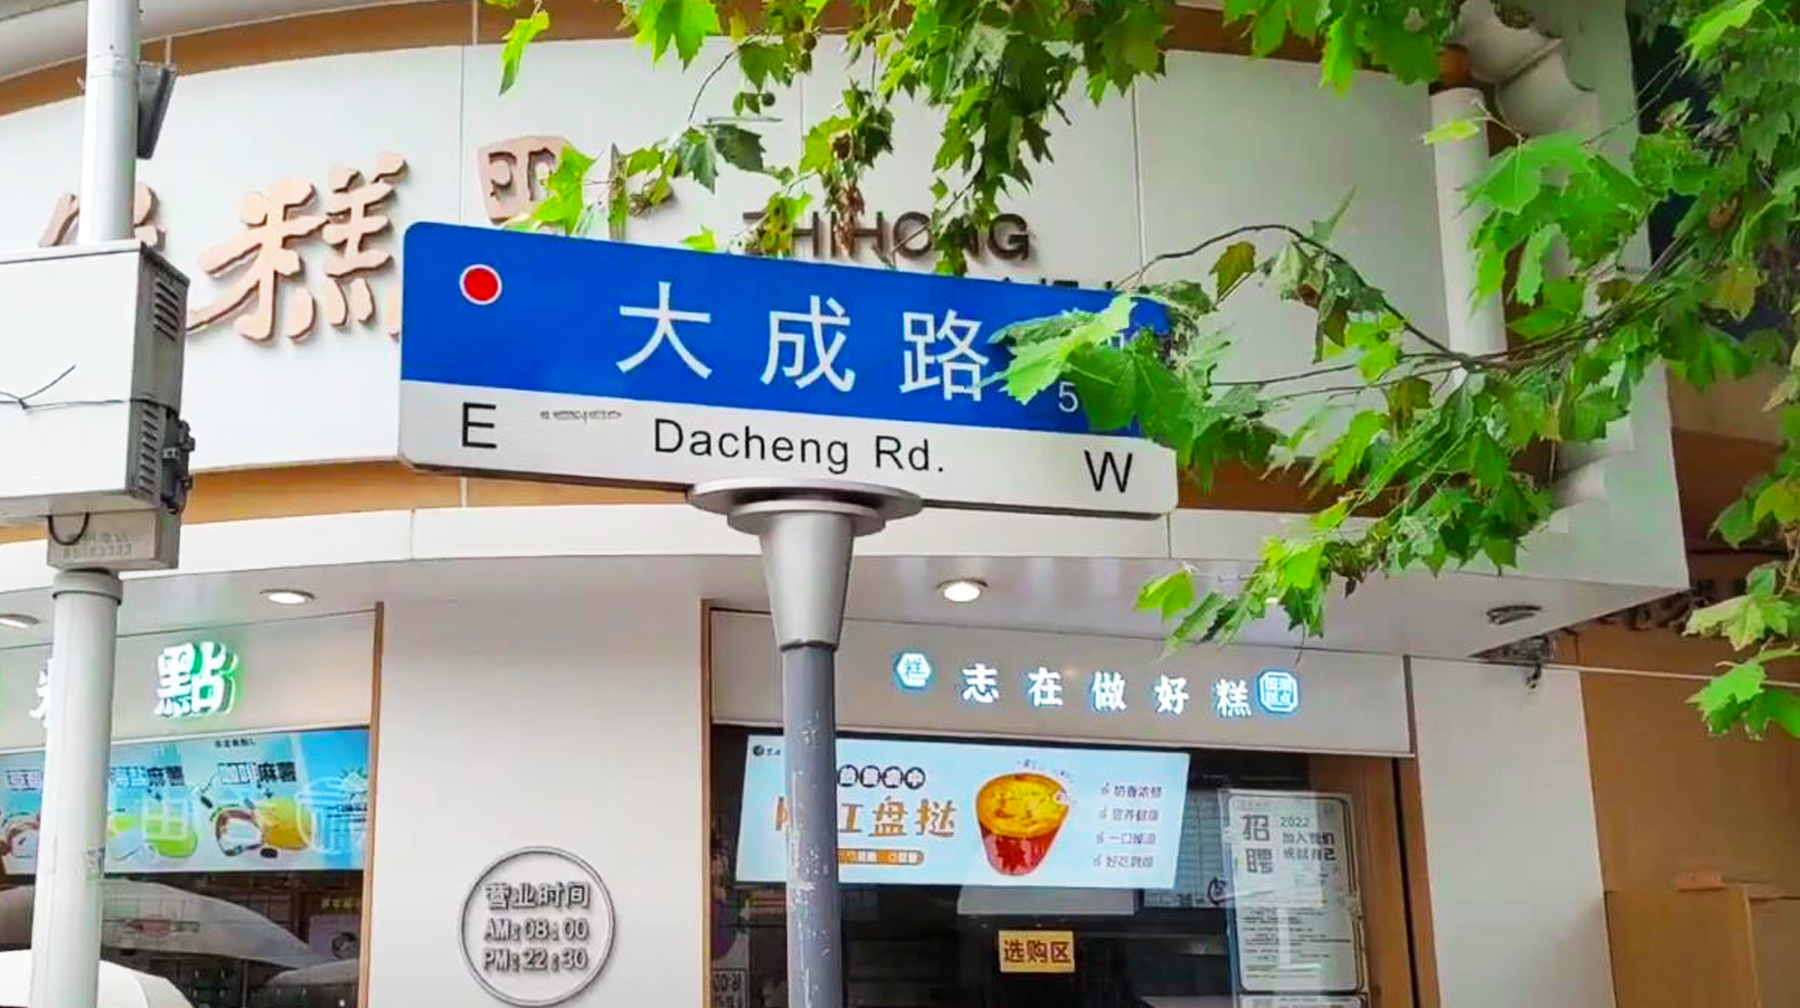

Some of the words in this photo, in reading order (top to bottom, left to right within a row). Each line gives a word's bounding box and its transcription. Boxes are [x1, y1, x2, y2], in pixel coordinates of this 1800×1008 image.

[616, 281, 990, 402] 大成路
[461, 402, 497, 449] E
[654, 418, 849, 474] Dacheng
[875, 436, 944, 472] Rd.
[1084, 449, 1133, 494] W
[962, 664, 1252, 717] 志在做好糕
[1241, 814, 1273, 875] 招聘
[485, 881, 591, 910] 营业时间
[1004, 939, 1072, 964] 选购区
